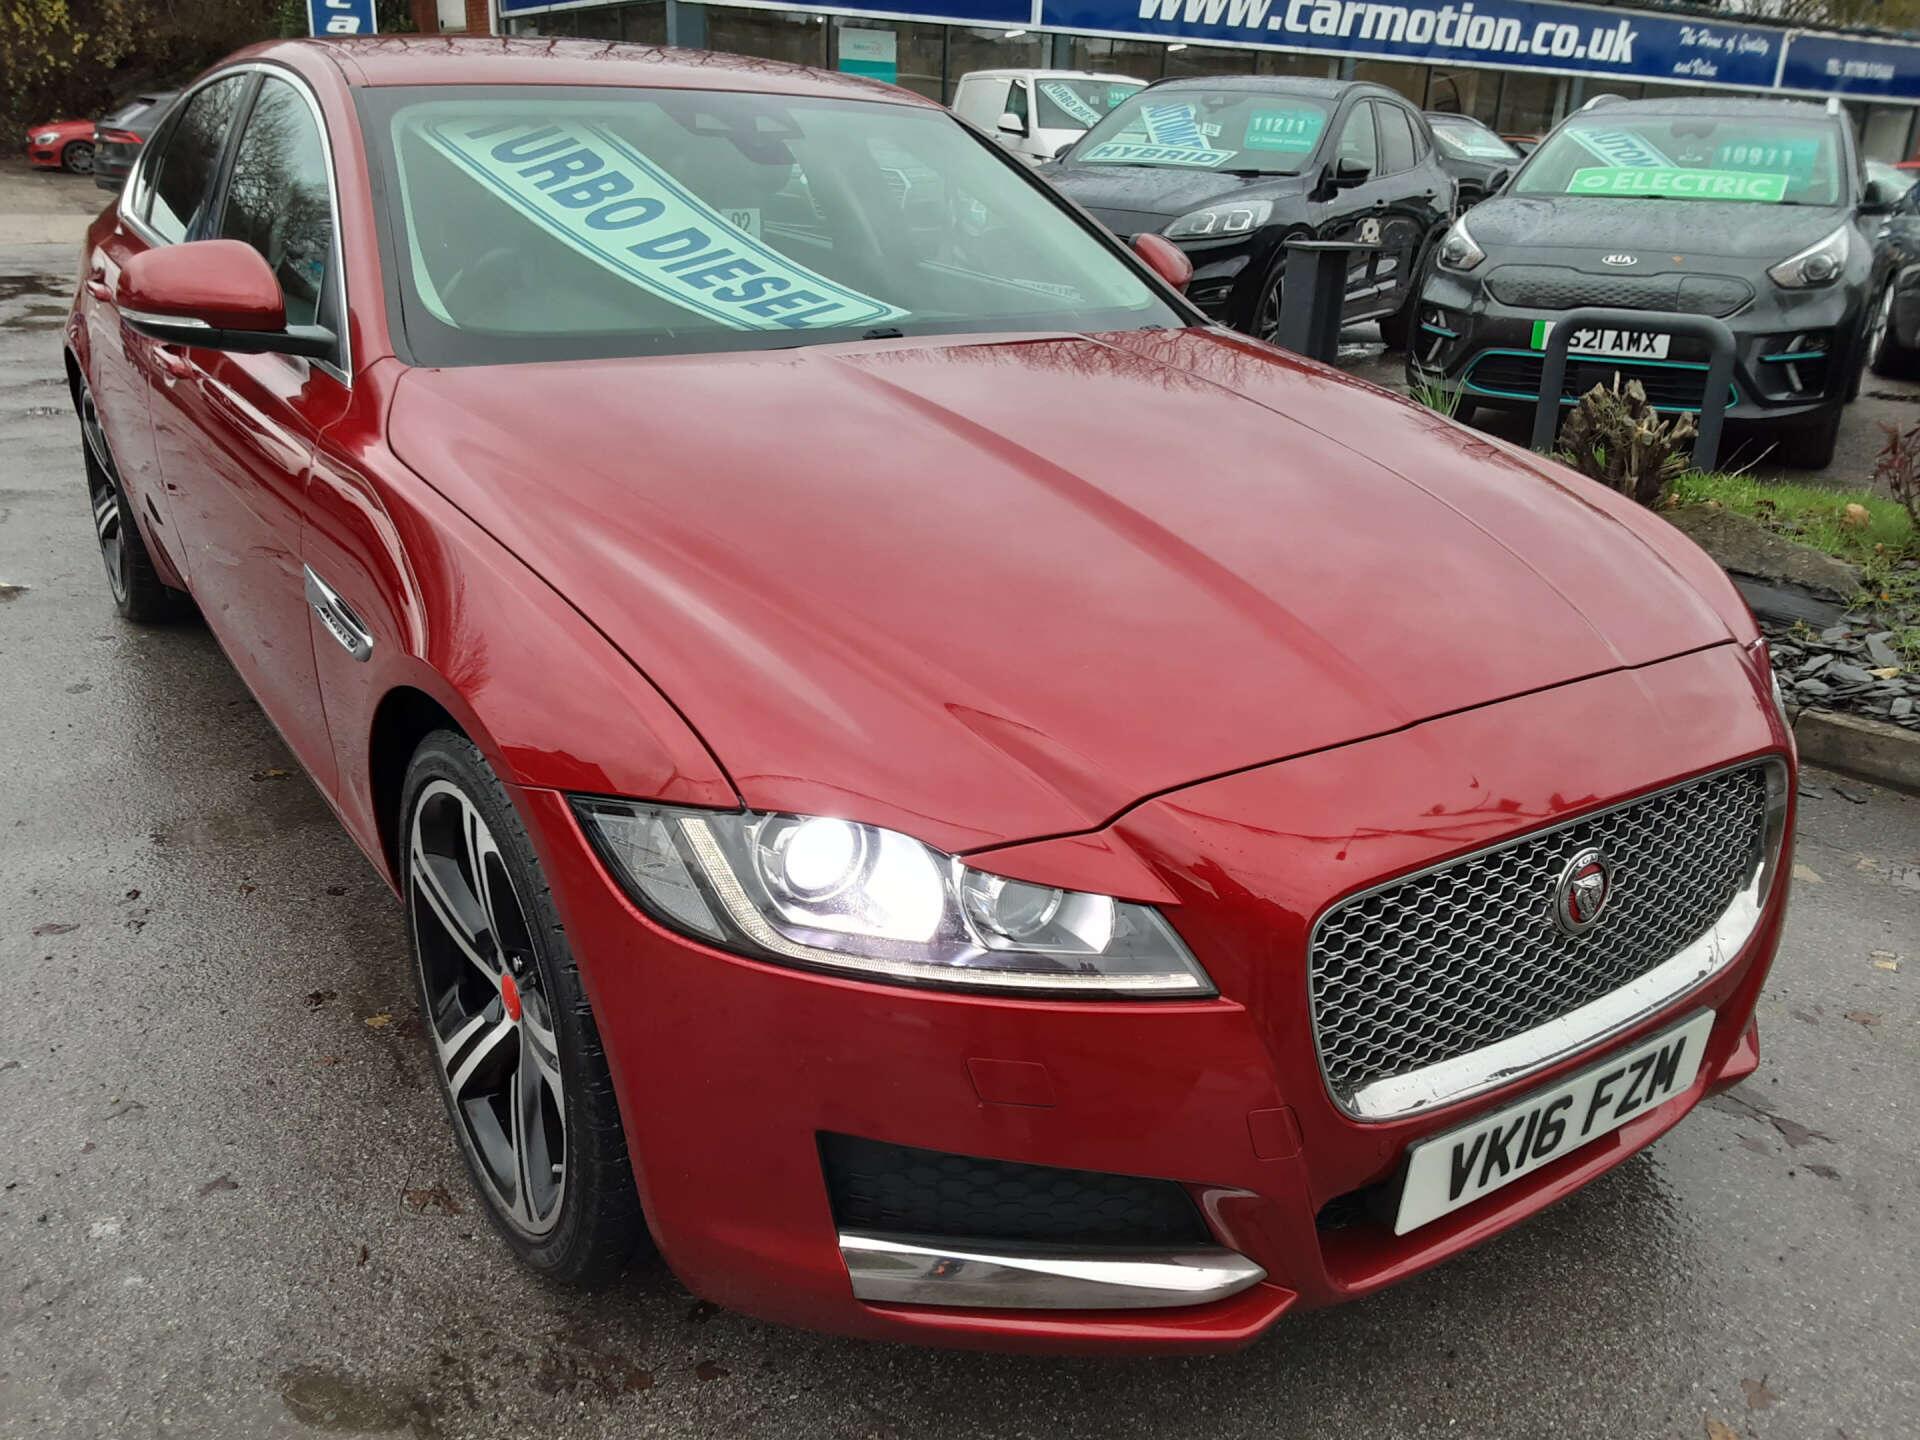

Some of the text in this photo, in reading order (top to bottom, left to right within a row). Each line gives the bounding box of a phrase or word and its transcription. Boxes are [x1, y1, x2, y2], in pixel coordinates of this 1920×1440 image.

[1138, 0, 1639, 63] www.carmotion.co.uk
[1092, 145, 1219, 163] HYBRID
[1611, 171, 1772, 196] ELECTRIC
[464, 117, 846, 331] TURBO DIESEL
[1607, 254, 1632, 264] KIA
[1611, 331, 1658, 354] AMX
[1449, 1036, 1687, 1201] VK16 FZM
